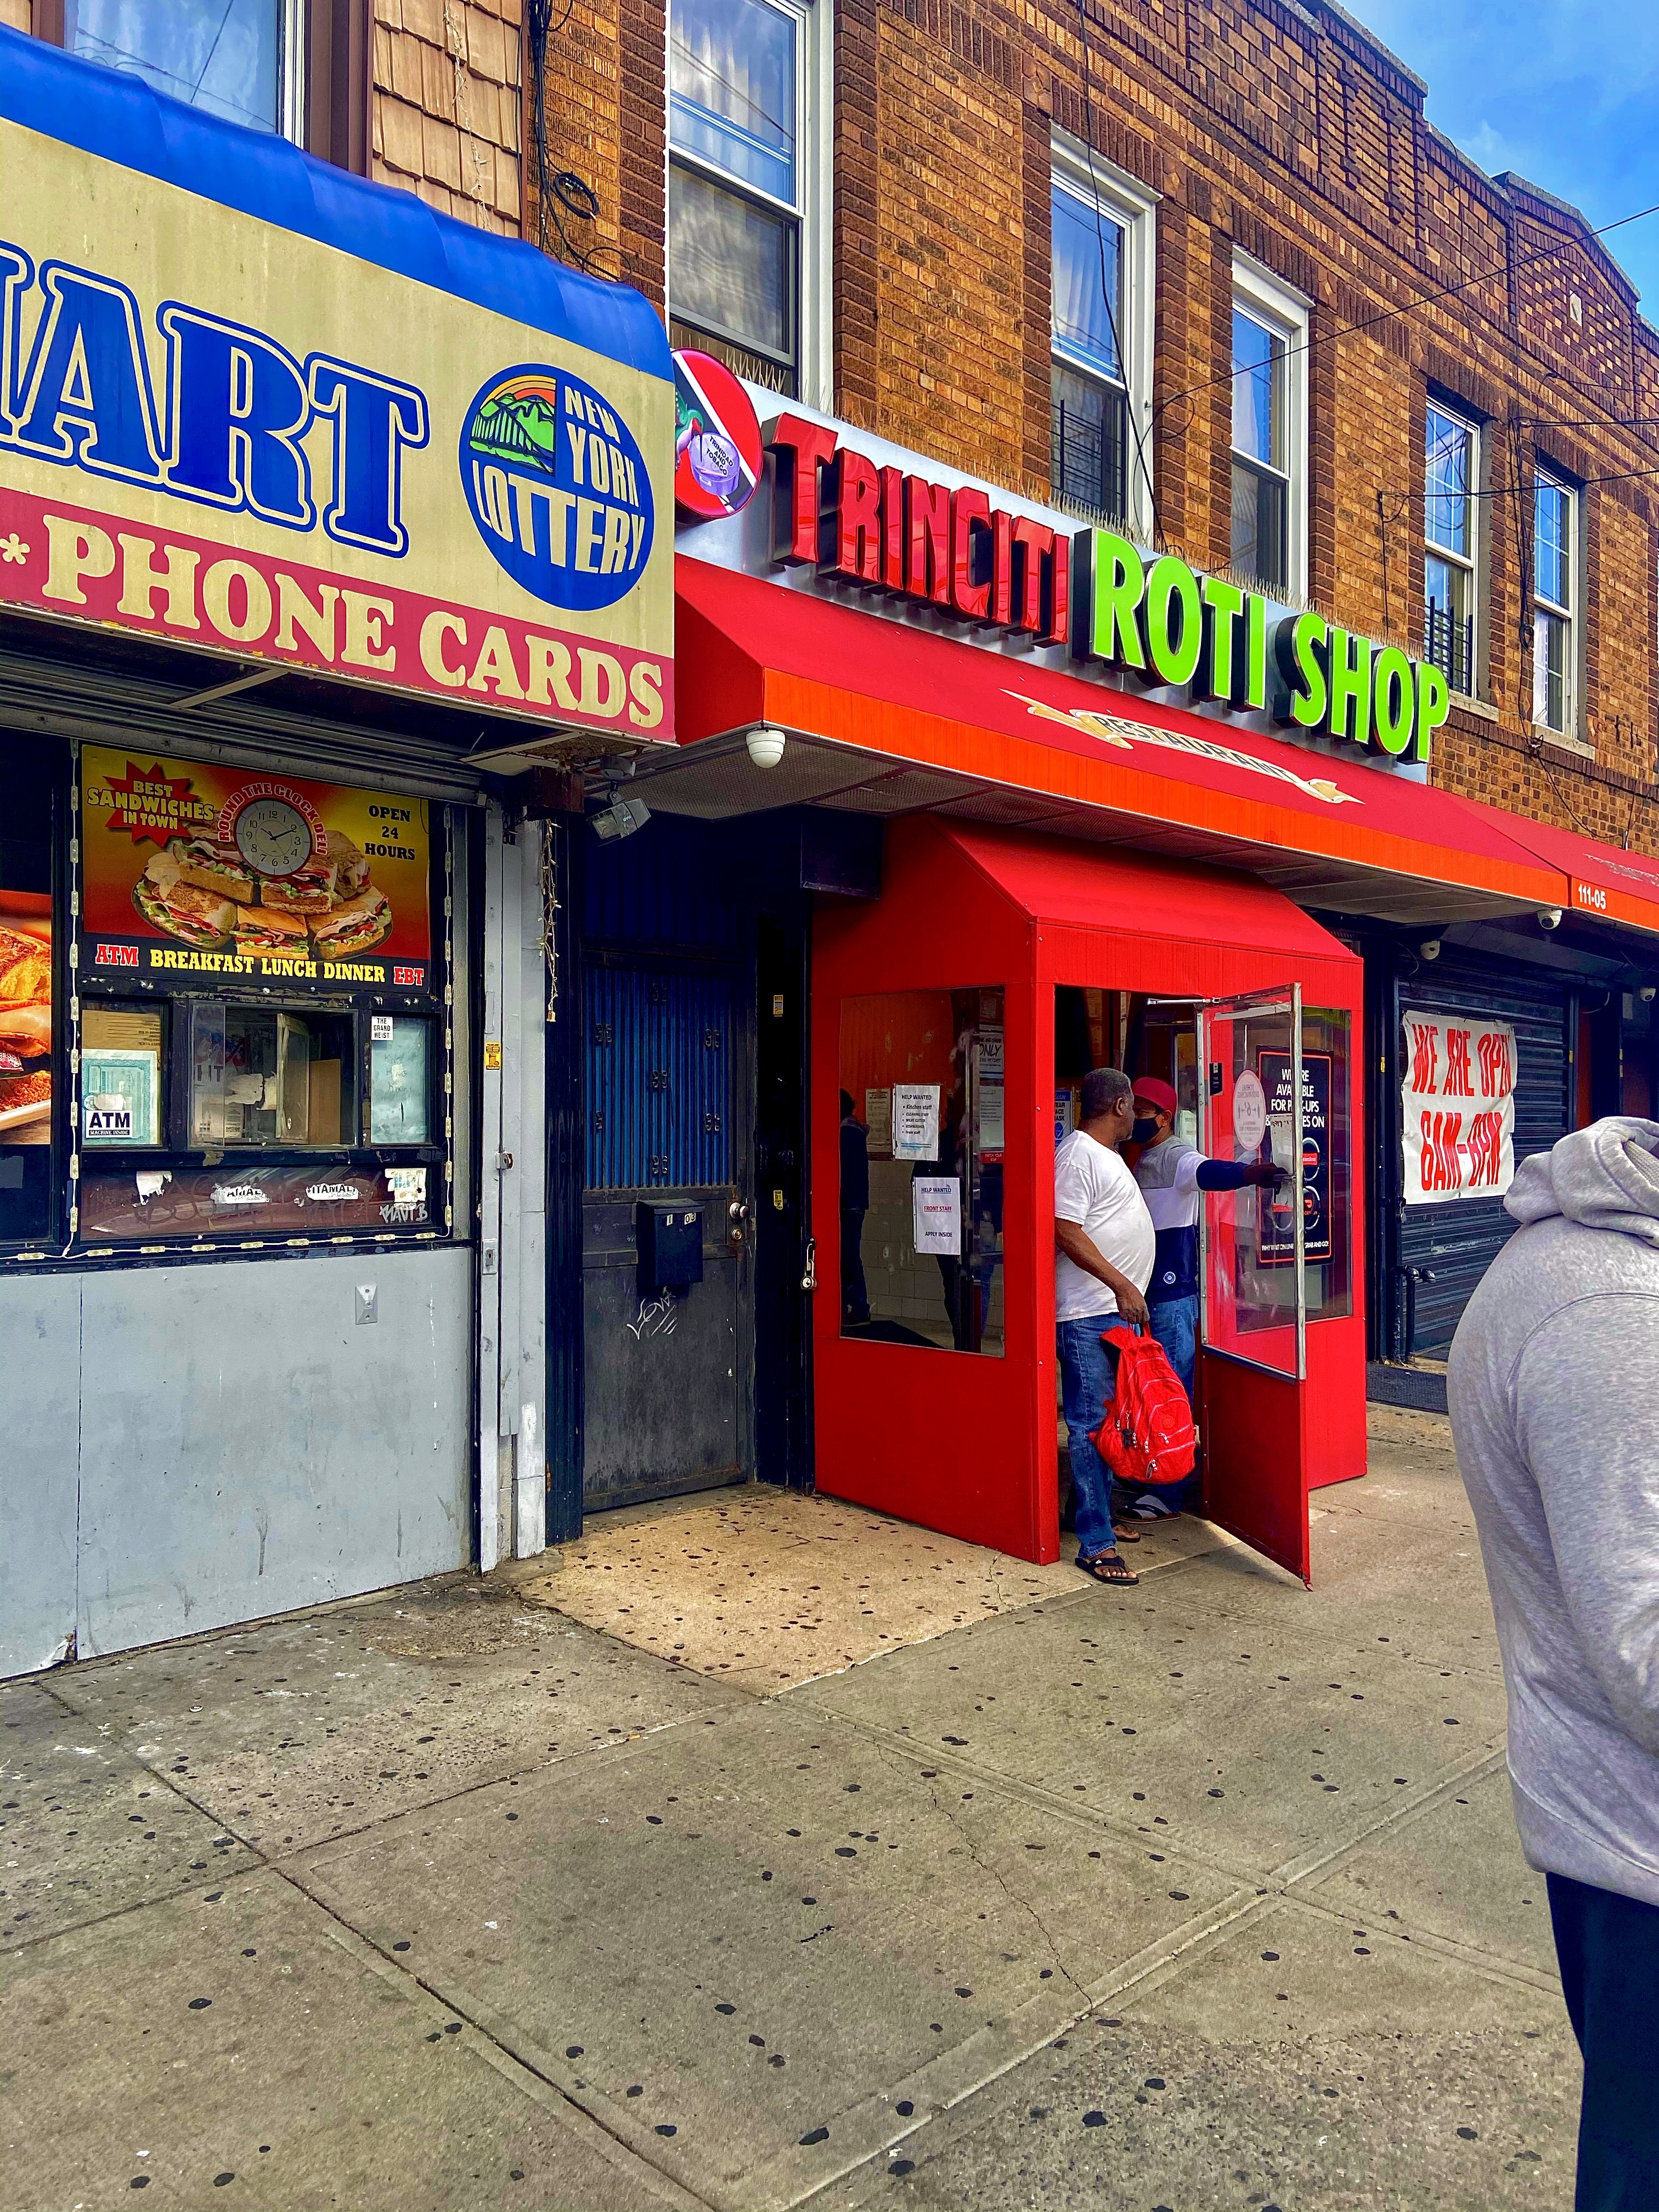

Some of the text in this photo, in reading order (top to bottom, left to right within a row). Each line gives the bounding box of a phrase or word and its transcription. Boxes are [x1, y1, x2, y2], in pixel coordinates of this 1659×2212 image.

[565, 386, 620, 444] NEW
[709, 436, 733, 467] TRINIDAD
[714, 450, 726, 466] AND
[566, 421, 639, 507] YORK
[706, 448, 727, 476] TOBAGO
[472, 459, 645, 574] LOTTERY
[764, 412, 1069, 644] TRINCITI
[42, 515, 665, 729] PHONE CARDS
[1092, 527, 1450, 763] ROTI SHOP
[1091, 715, 1298, 783] RESTAURANT
[133, 780, 173, 797] BEST
[87, 787, 215, 821] SANDWICHES
[122, 810, 178, 831] IN TOWN
[217, 782, 328, 855] ROUND THE CLOCK DELI
[258, 812, 265, 821] 11
[269, 810, 278, 819] 12
[283, 815, 286, 823] 1
[368, 804, 411, 822] OPEN
[249, 820, 258, 828] 10
[291, 824, 297, 832] 2
[246, 831, 252, 840] 9
[294, 837, 301, 845] 3
[381, 826, 399, 840] 24
[251, 843, 257, 853] 8
[291, 849, 297, 857] 4
[364, 842, 415, 861] HOURS
[259, 854, 267, 862] 7
[272, 858, 278, 867] 6
[283, 856, 290, 865] 5
[1578, 884, 1606, 910] 111-05
[95, 944, 425, 986] ATM BREAKFAST LUNCH DINNER EBT
[1412, 1023, 1511, 1098] WE ARE OPEN
[1276, 1084, 1314, 1097] AVABLE
[1271, 1098, 1286, 1111] FOR
[89, 1112, 130, 1128] ATM
[1312, 1115, 1325, 1128] ON
